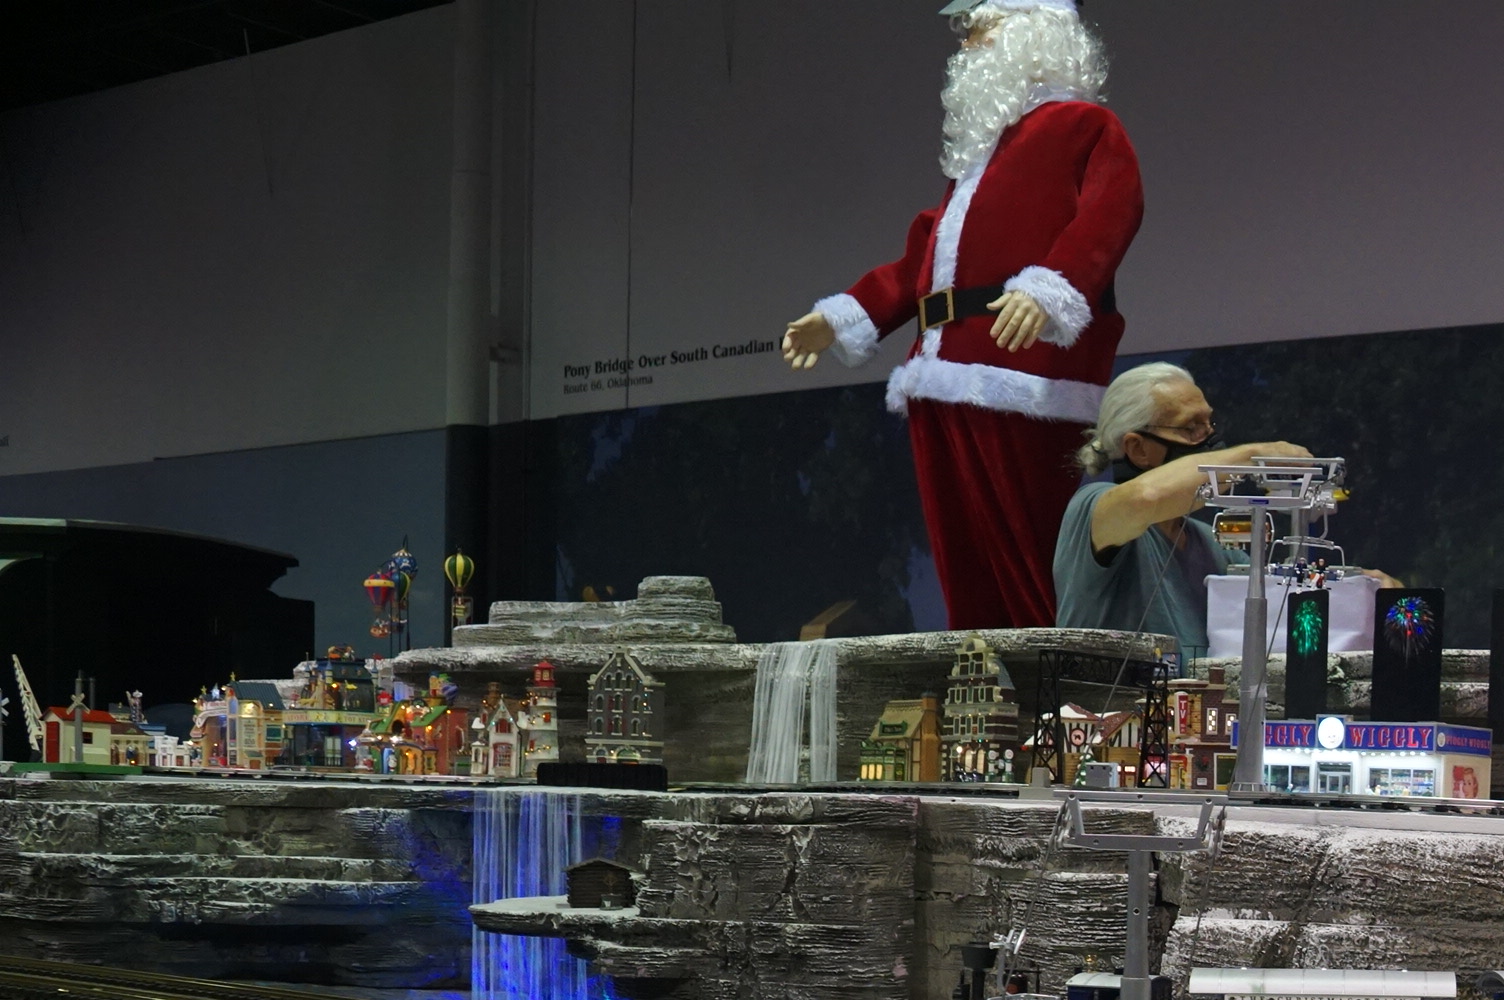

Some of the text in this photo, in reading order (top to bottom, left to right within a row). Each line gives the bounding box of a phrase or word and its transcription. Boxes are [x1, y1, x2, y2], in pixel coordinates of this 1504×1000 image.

[564, 364, 592, 380] Pony
[595, 358, 634, 374] Bridge
[638, 354, 666, 369] Over
[670, 348, 708, 365] South
[712, 338, 774, 360] Canadian
[563, 382, 589, 395] Route
[607, 375, 653, 389] Oklahoma
[1350, 726, 1432, 748] WIGGLY
